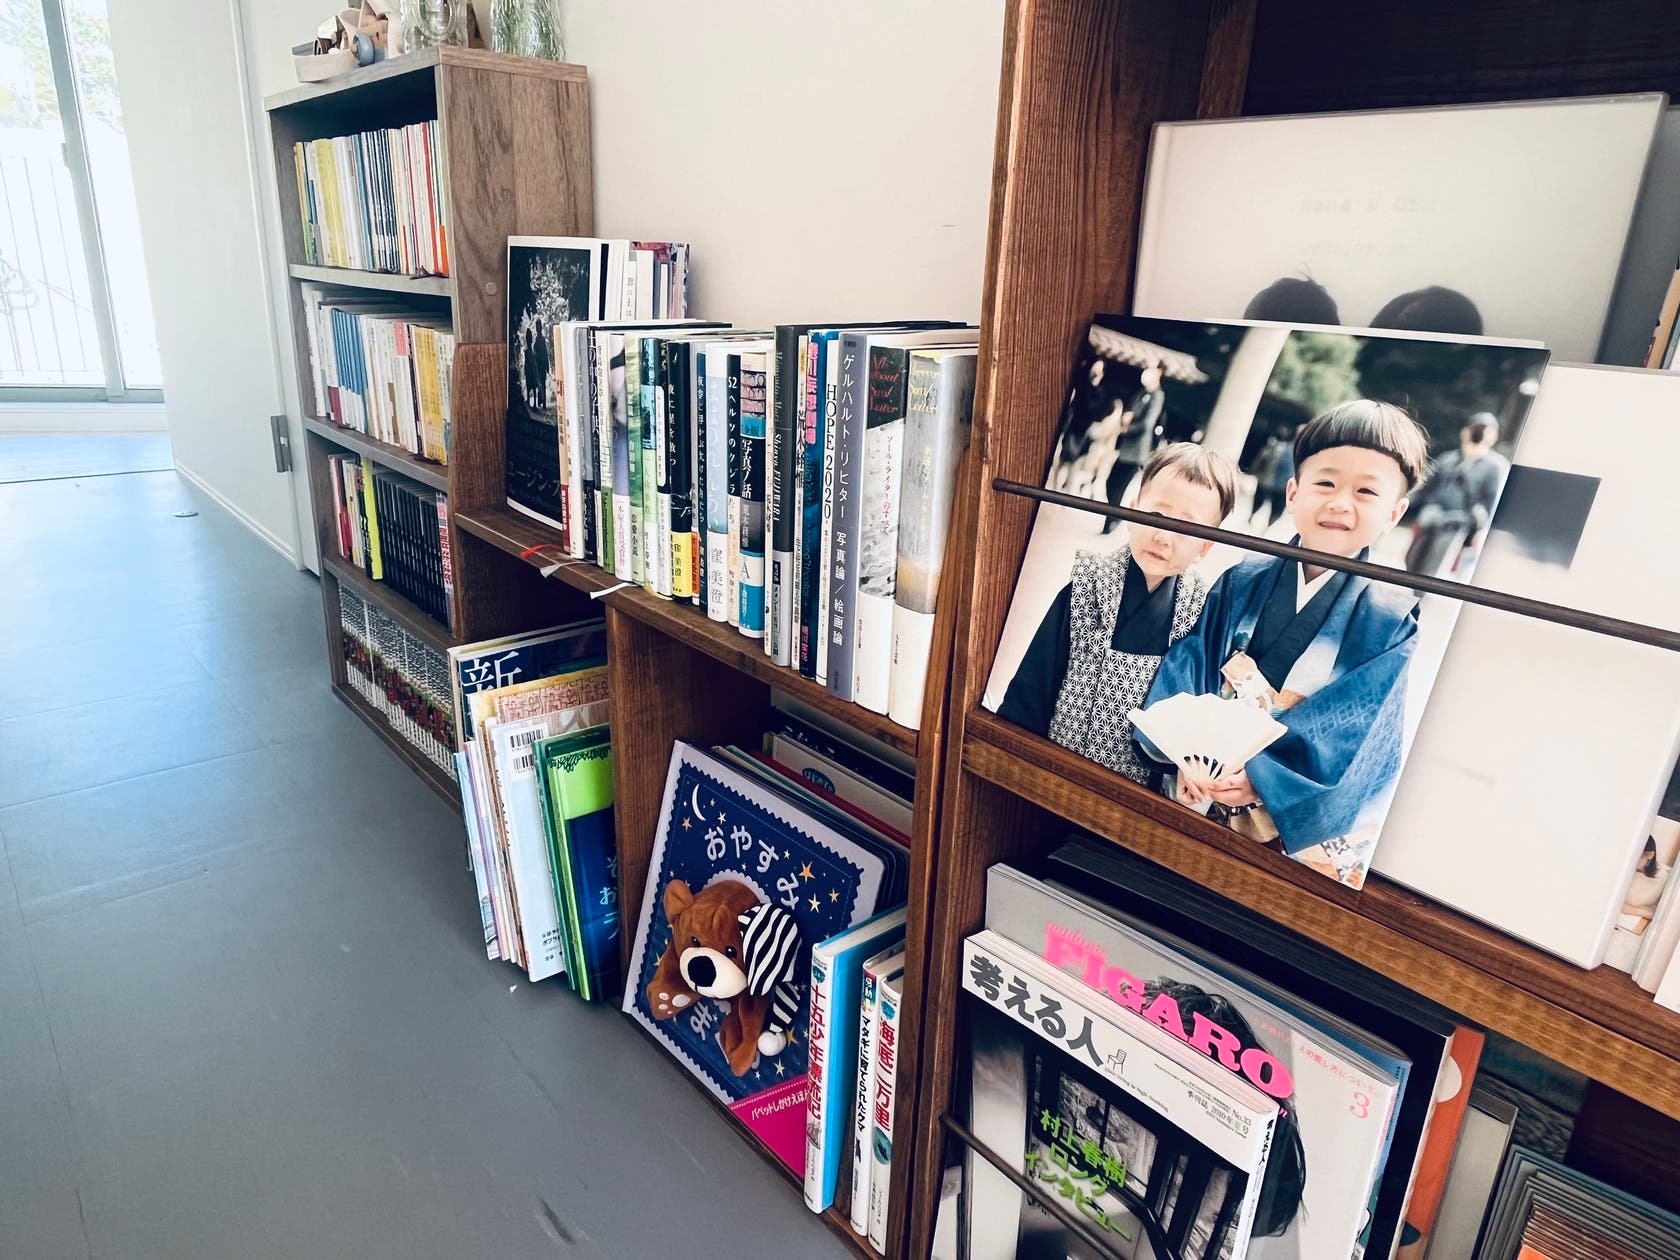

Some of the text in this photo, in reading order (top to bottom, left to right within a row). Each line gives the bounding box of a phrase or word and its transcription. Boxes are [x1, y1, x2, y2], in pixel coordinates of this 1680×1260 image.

[825, 384, 838, 450] HOPE
[837, 353, 855, 518] ゲルハルト・リヒター
[741, 439, 753, 499] 写真ノ話
[880, 435, 894, 535] ソール・ライターのすべて
[710, 547, 724, 604] 窪美澄
[461, 651, 522, 692] 新
[704, 825, 799, 910] おやすみ
[970, 954, 1104, 1067] 考える人
[1043, 932, 1294, 1099] FIGARO
[808, 984, 825, 1121] 十五少年漂流記
[1348, 1092, 1372, 1119] 3
[1040, 1108, 1127, 1188] 村上春樹
[1049, 1141, 1108, 1196] ロング
